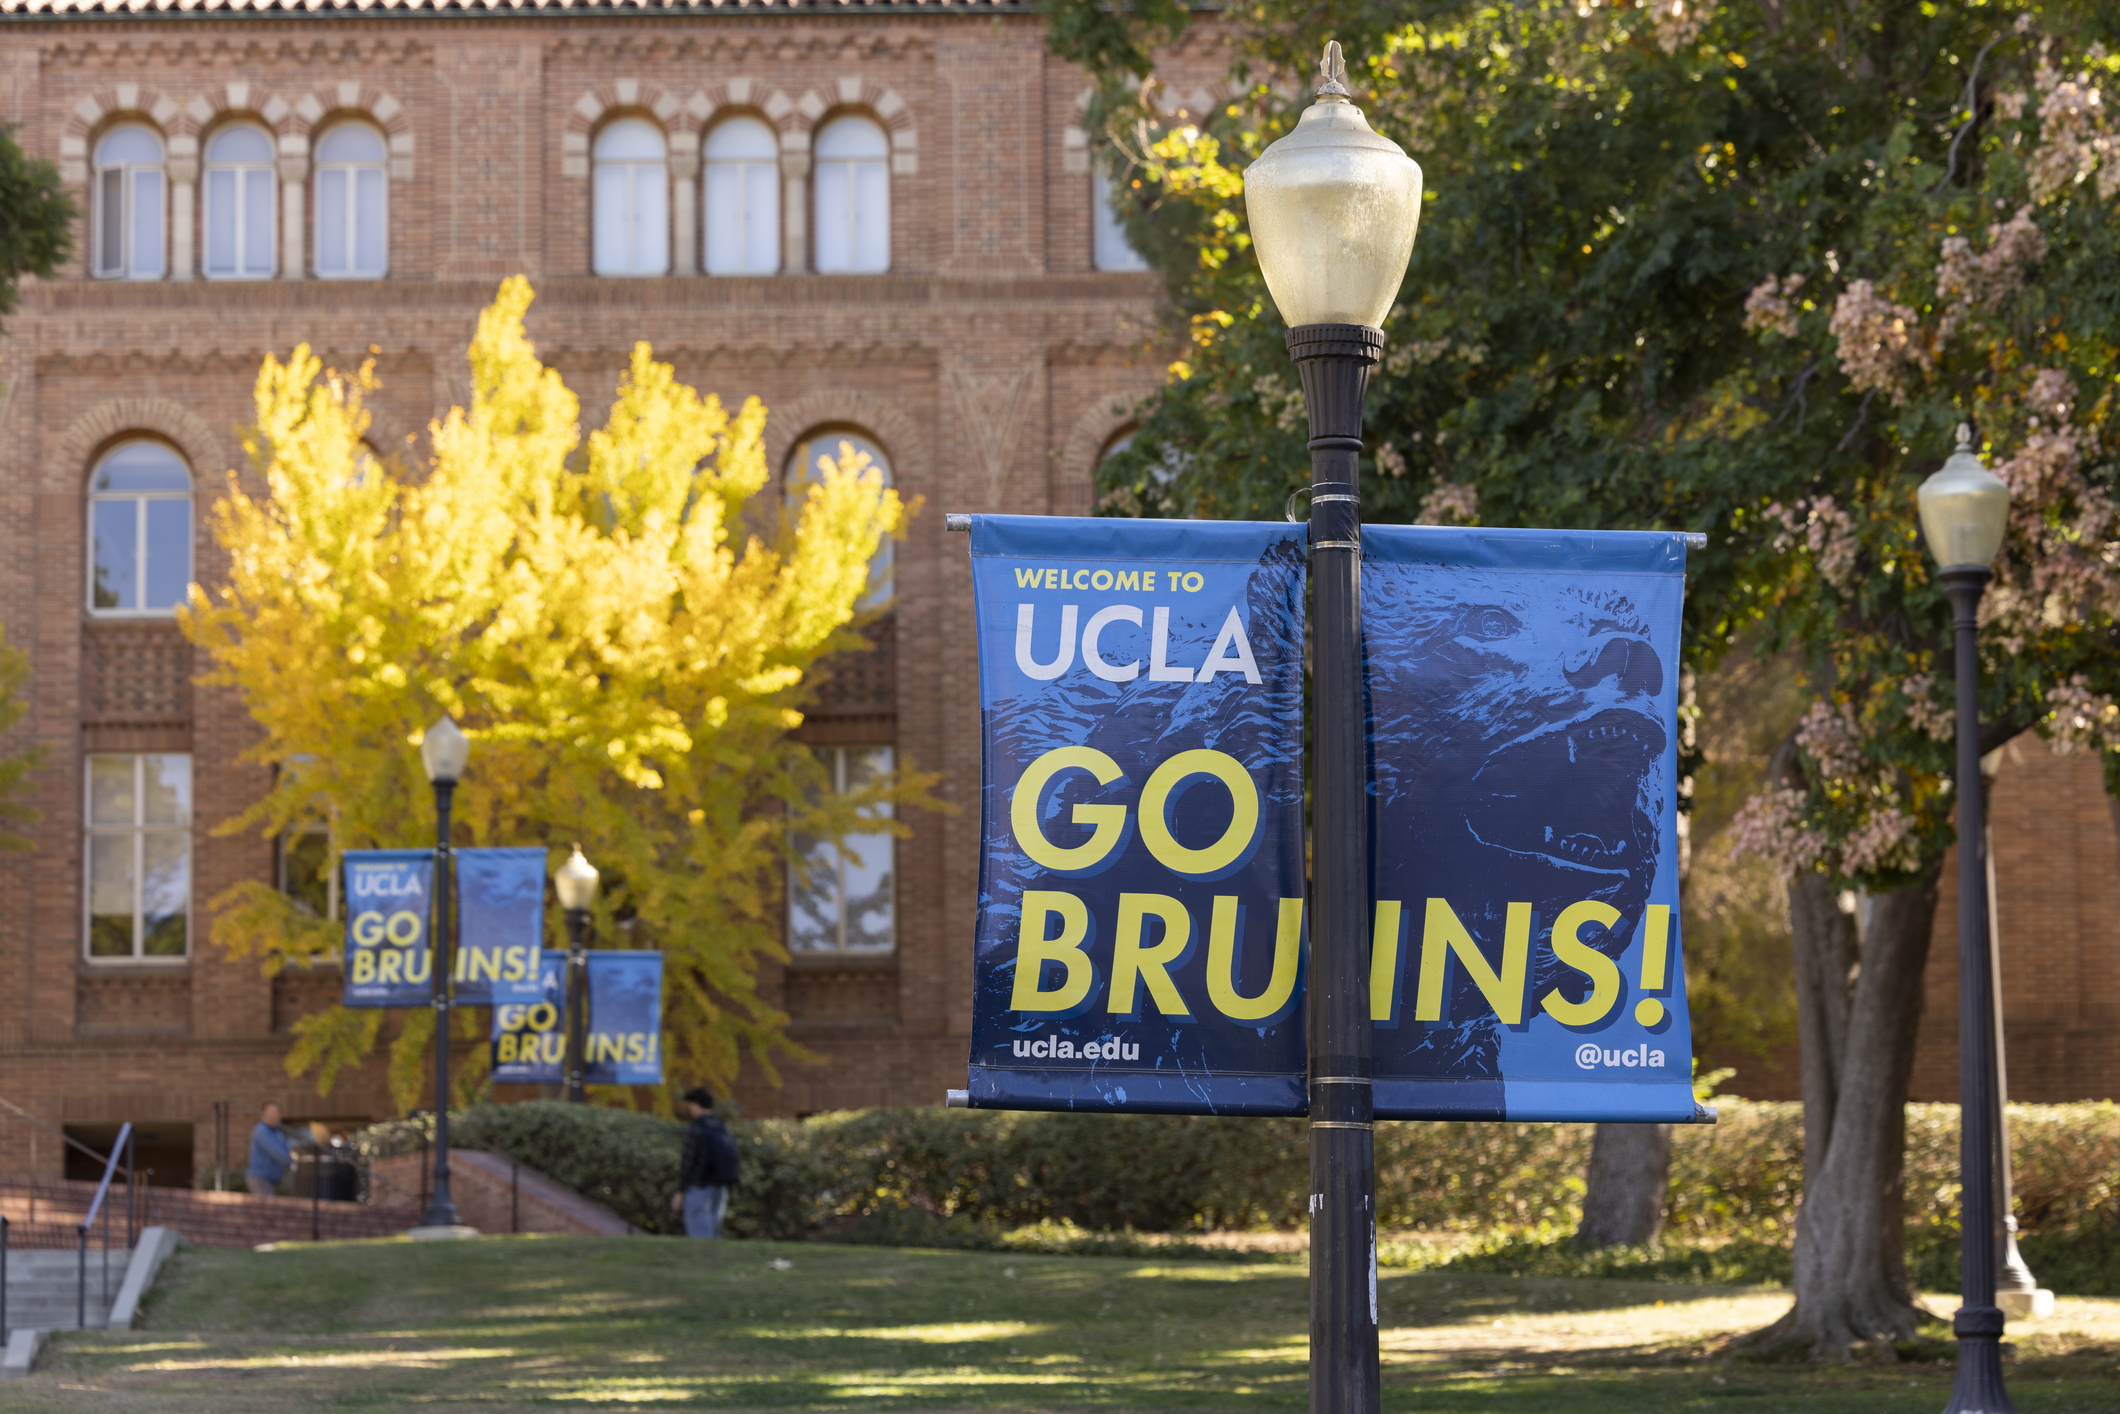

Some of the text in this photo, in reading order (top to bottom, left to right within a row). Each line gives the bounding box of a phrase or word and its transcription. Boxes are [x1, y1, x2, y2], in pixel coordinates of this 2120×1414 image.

[1014, 568, 1205, 593] WELCOME TO
[1014, 602, 1263, 685] UCLA
[1010, 745, 1260, 874] GO
[354, 873, 422, 897] UCLA
[352, 910, 422, 947] GO
[497, 1002, 558, 1033] GO
[1013, 1034, 1140, 1061] ucla.edu
[1574, 1042, 1666, 1070] @ucla
